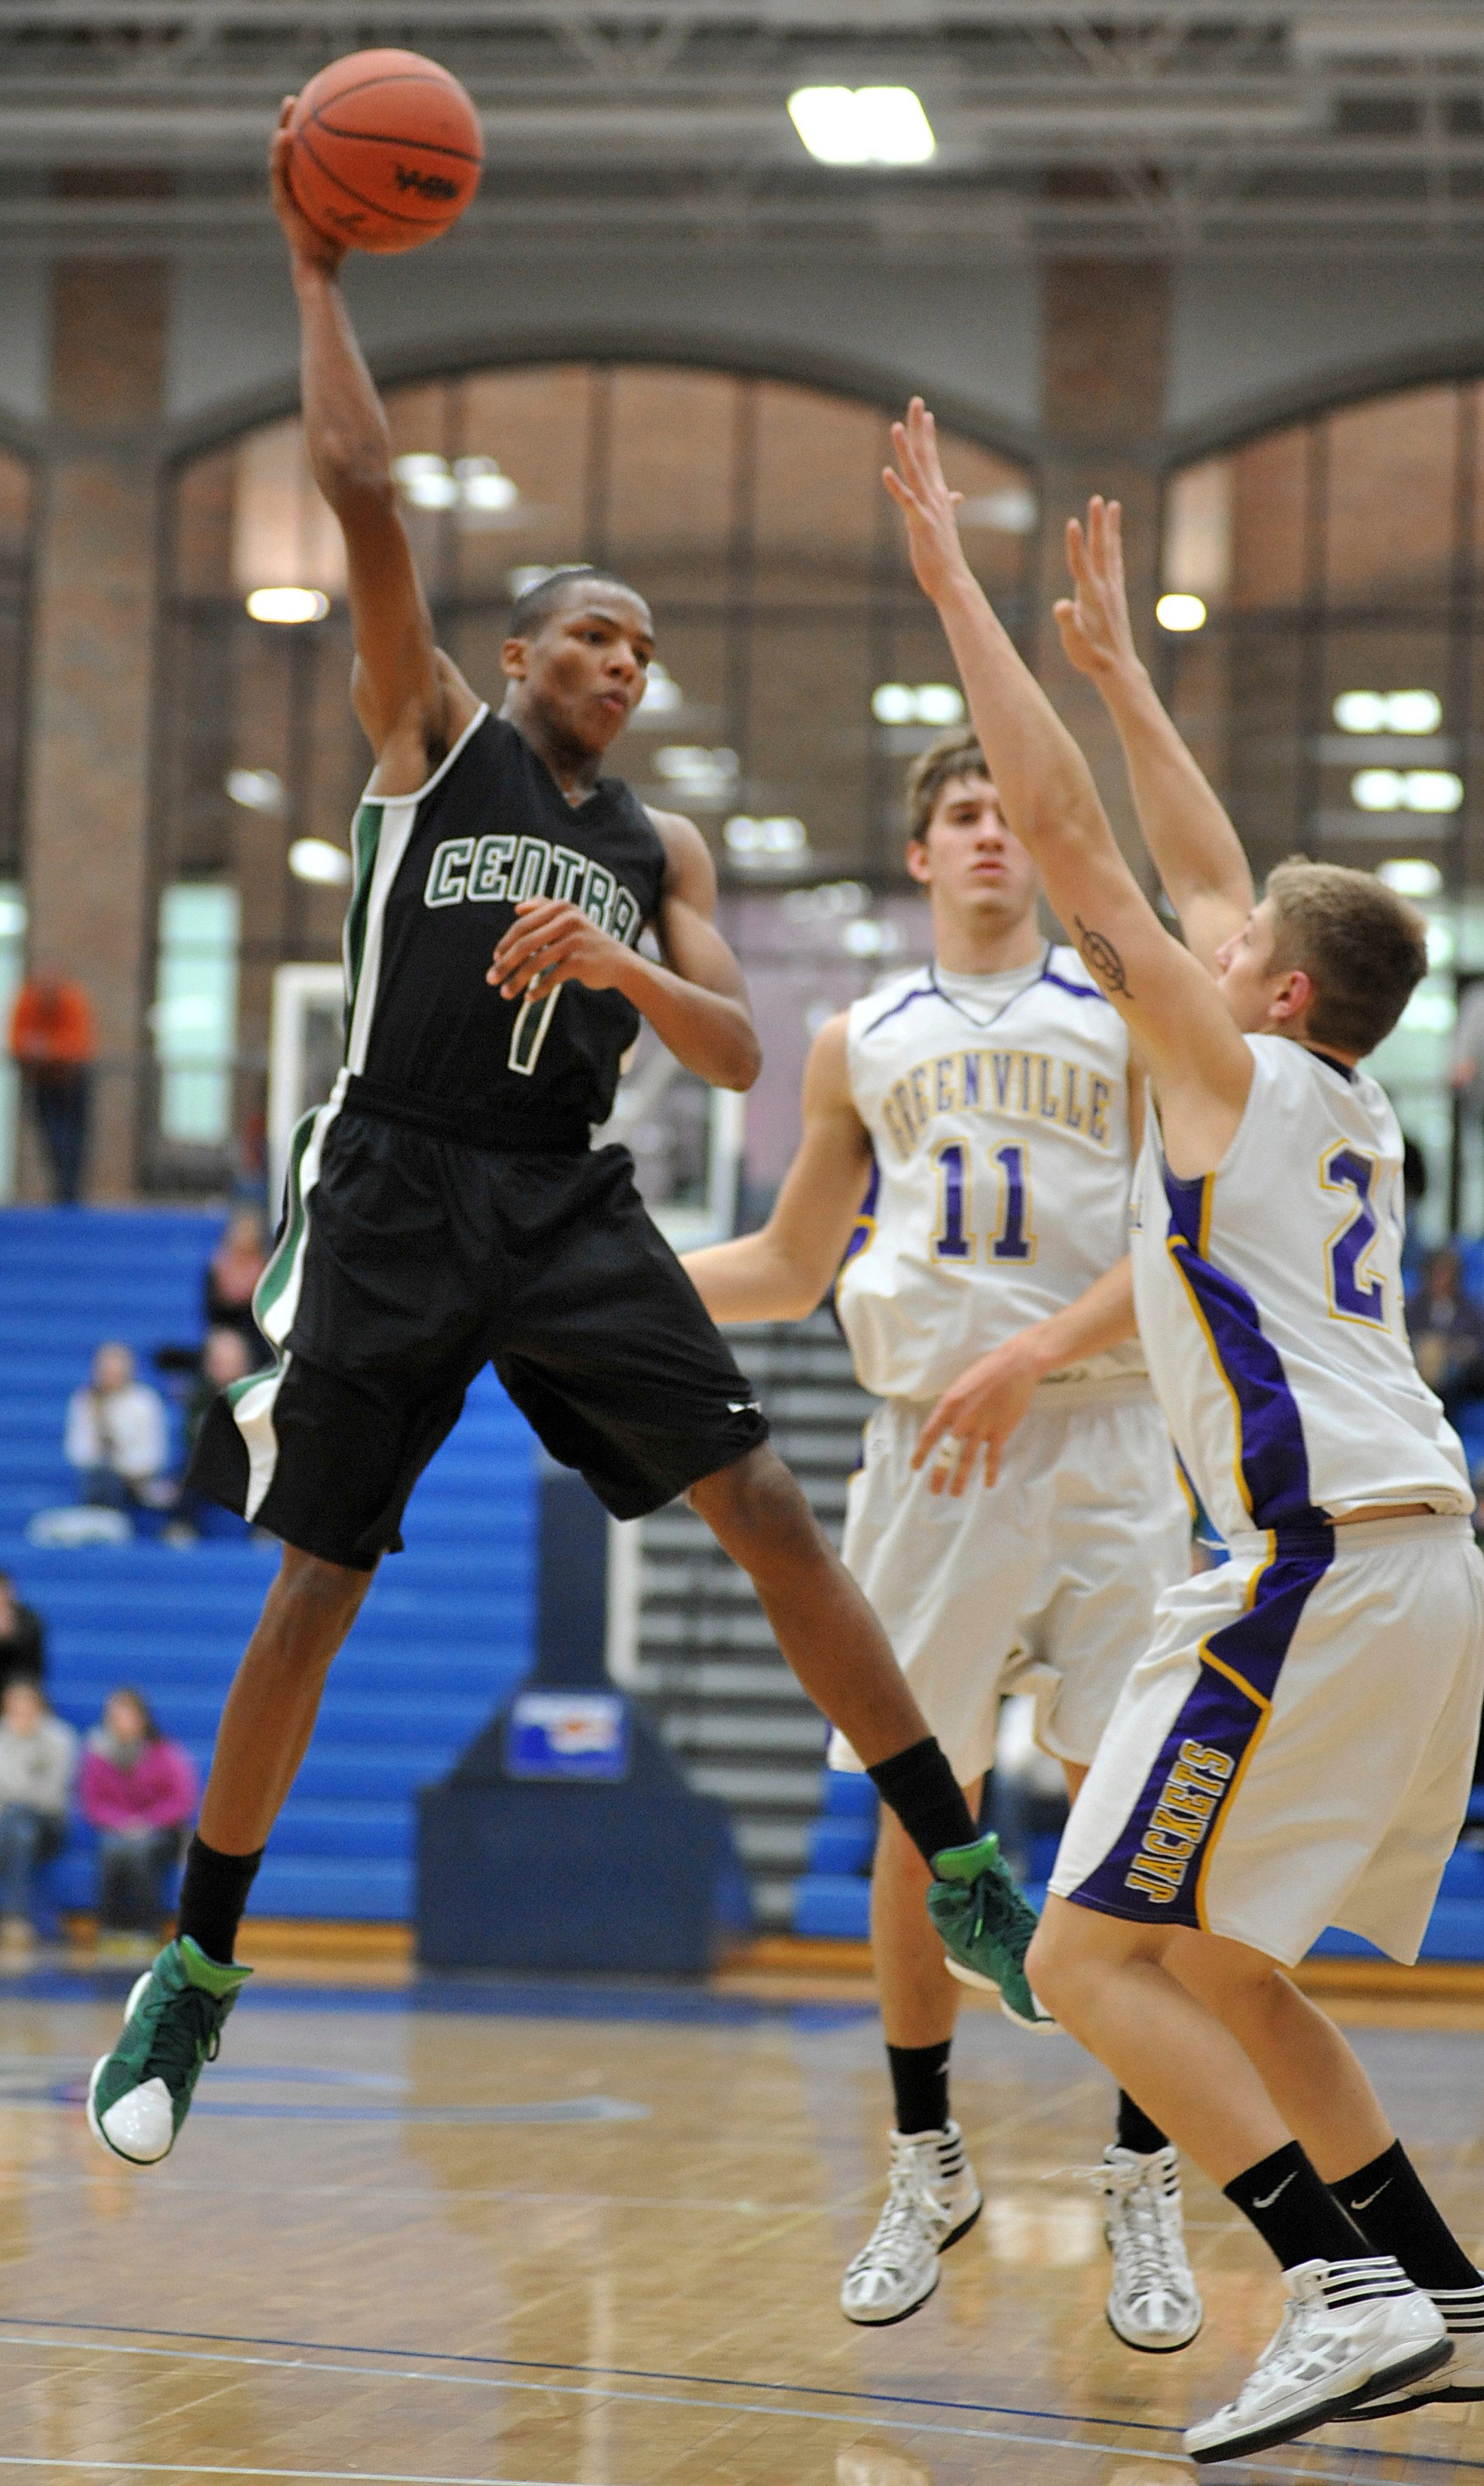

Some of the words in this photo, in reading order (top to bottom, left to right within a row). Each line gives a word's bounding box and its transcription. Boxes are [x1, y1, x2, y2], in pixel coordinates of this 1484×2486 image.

[881, 1048, 1113, 1165] GREENVILLE
[929, 1137, 1038, 1266] 11
[1125, 1739, 1235, 1903] JACKETS
